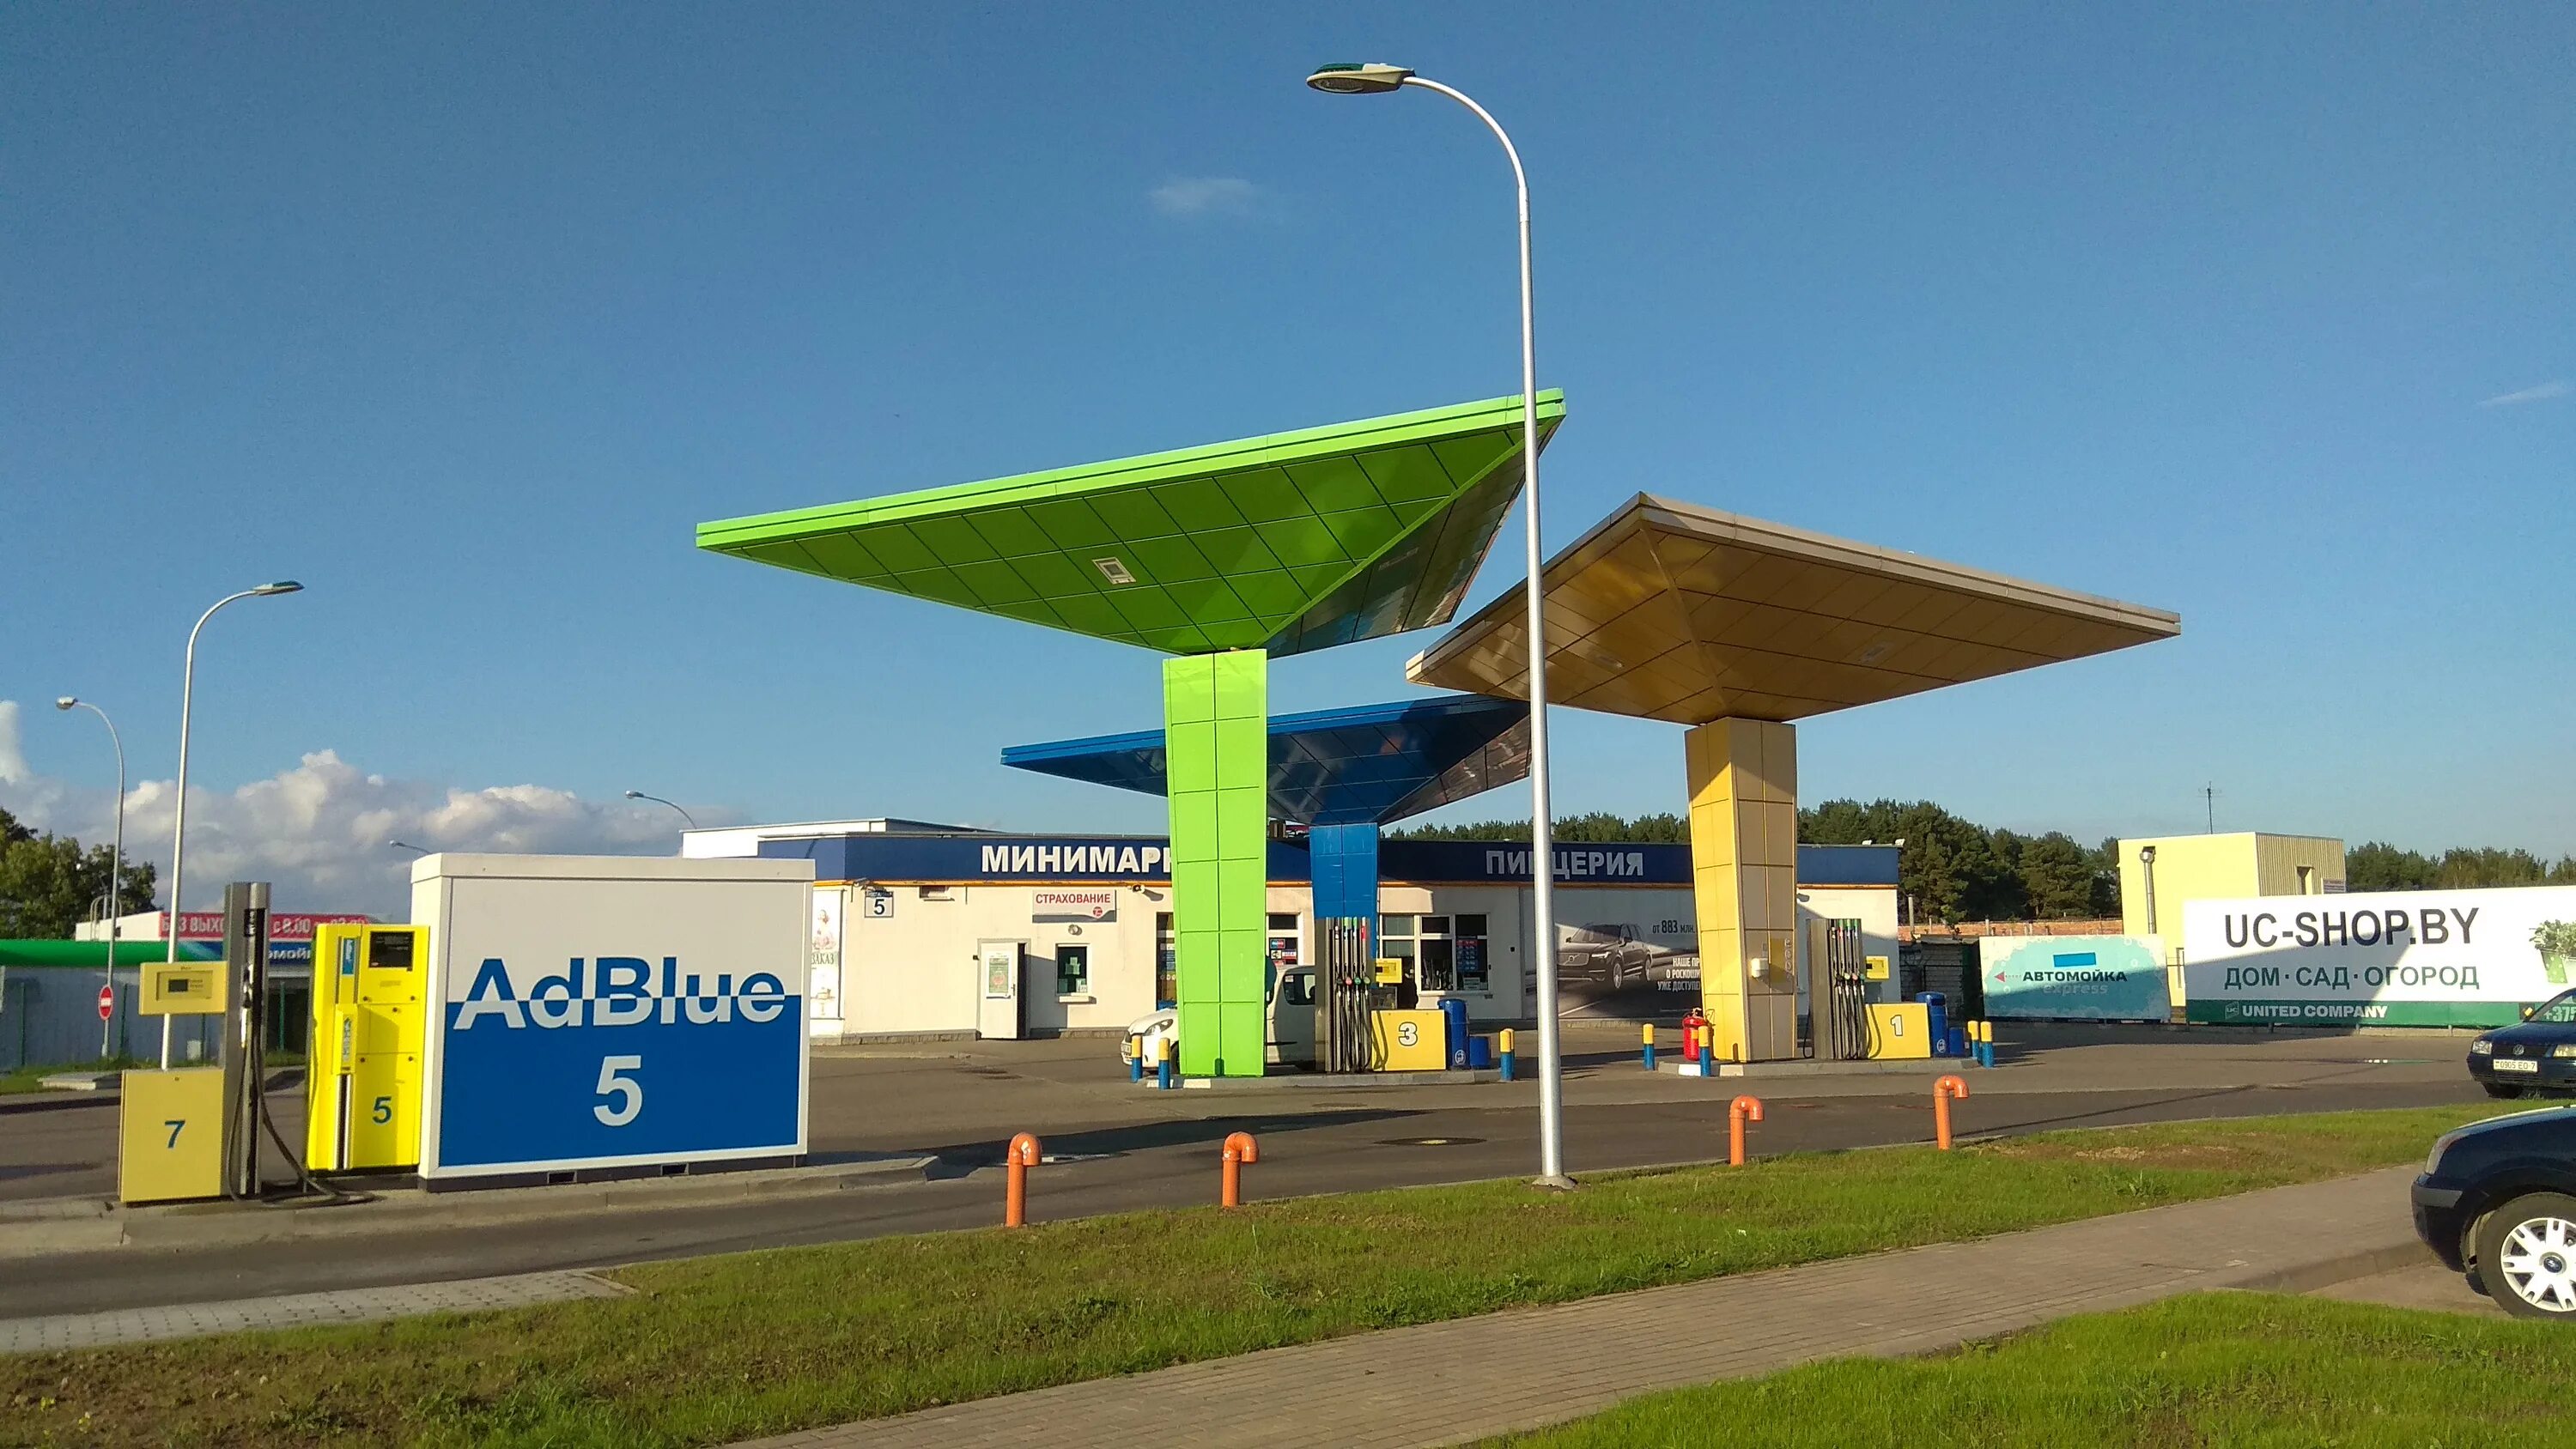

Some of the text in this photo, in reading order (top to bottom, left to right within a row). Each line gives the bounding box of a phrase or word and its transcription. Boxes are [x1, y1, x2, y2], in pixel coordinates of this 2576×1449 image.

[1485, 850, 1643, 880] ПИЦЕРИЯ
[874, 899, 885, 915] 5
[1036, 894, 1110, 904] СТРАХОВАНИЕ
[162, 916, 186, 931] БЗ
[1662, 920, 1678, 934] 883
[2225, 907, 2479, 948] UC-SHOP.BY
[1673, 957, 1691, 967] НАШЕ
[2023, 969, 2128, 982] АВТОМОЙКА
[2224, 966, 2480, 990] ДОМ САД ОГОРОД
[453, 956, 785, 1030] AdBlue
[1657, 981, 1671, 991] УЖЕ
[2043, 983, 2108, 996] express
[2242, 1005, 2388, 1018] UNITED COMPANY
[1399, 1022, 1418, 1046] 3
[1890, 1015, 1903, 1036] 1
[593, 1055, 643, 1127] 5
[372, 1095, 392, 1125] 5
[164, 1119, 186, 1149] 7
